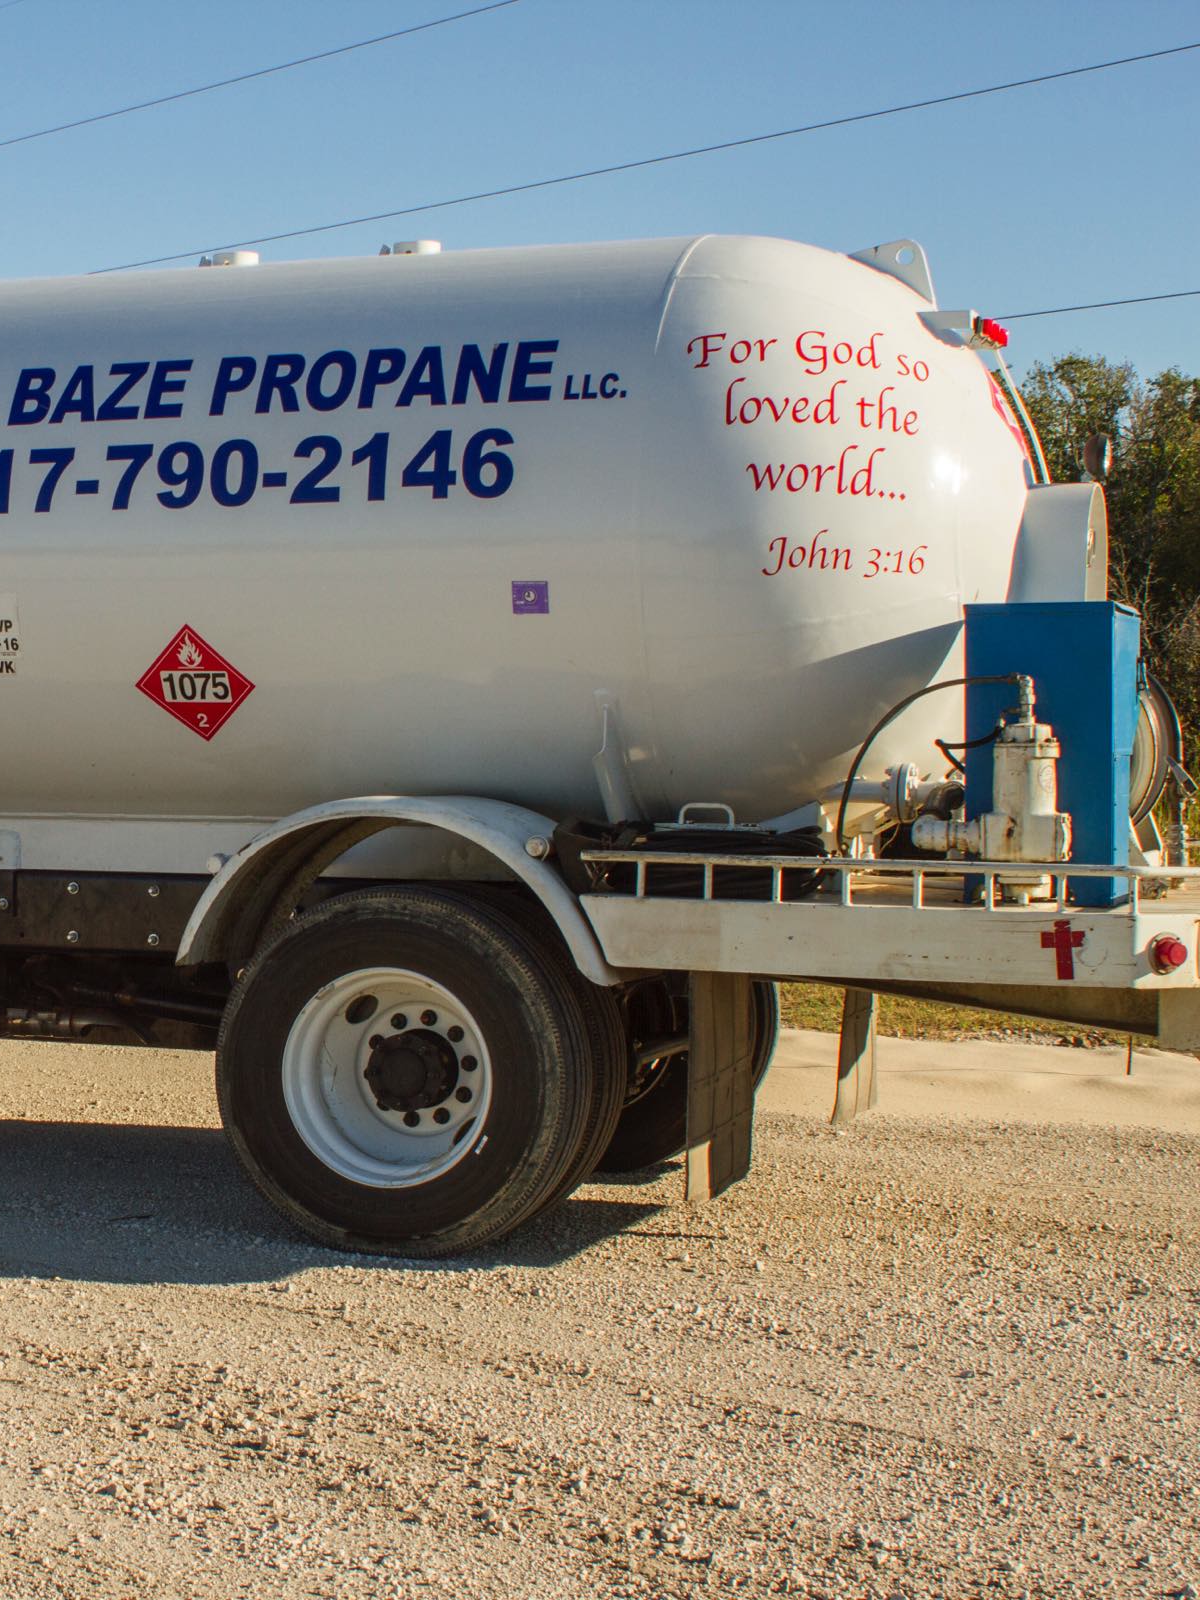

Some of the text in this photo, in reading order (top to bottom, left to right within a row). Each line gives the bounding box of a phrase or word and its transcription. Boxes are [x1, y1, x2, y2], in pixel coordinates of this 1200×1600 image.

[7, 358, 194, 425] BAZE
[209, 338, 560, 416] PROPANE
[564, 370, 629, 401] LLC.
[686, 330, 931, 382] For God so
[725, 377, 920, 437] loved the
[745, 444, 907, 502] world...
[761, 529, 929, 578] John 3:16
[162, 672, 230, 701] 1075
[196, 712, 210, 728] 2
